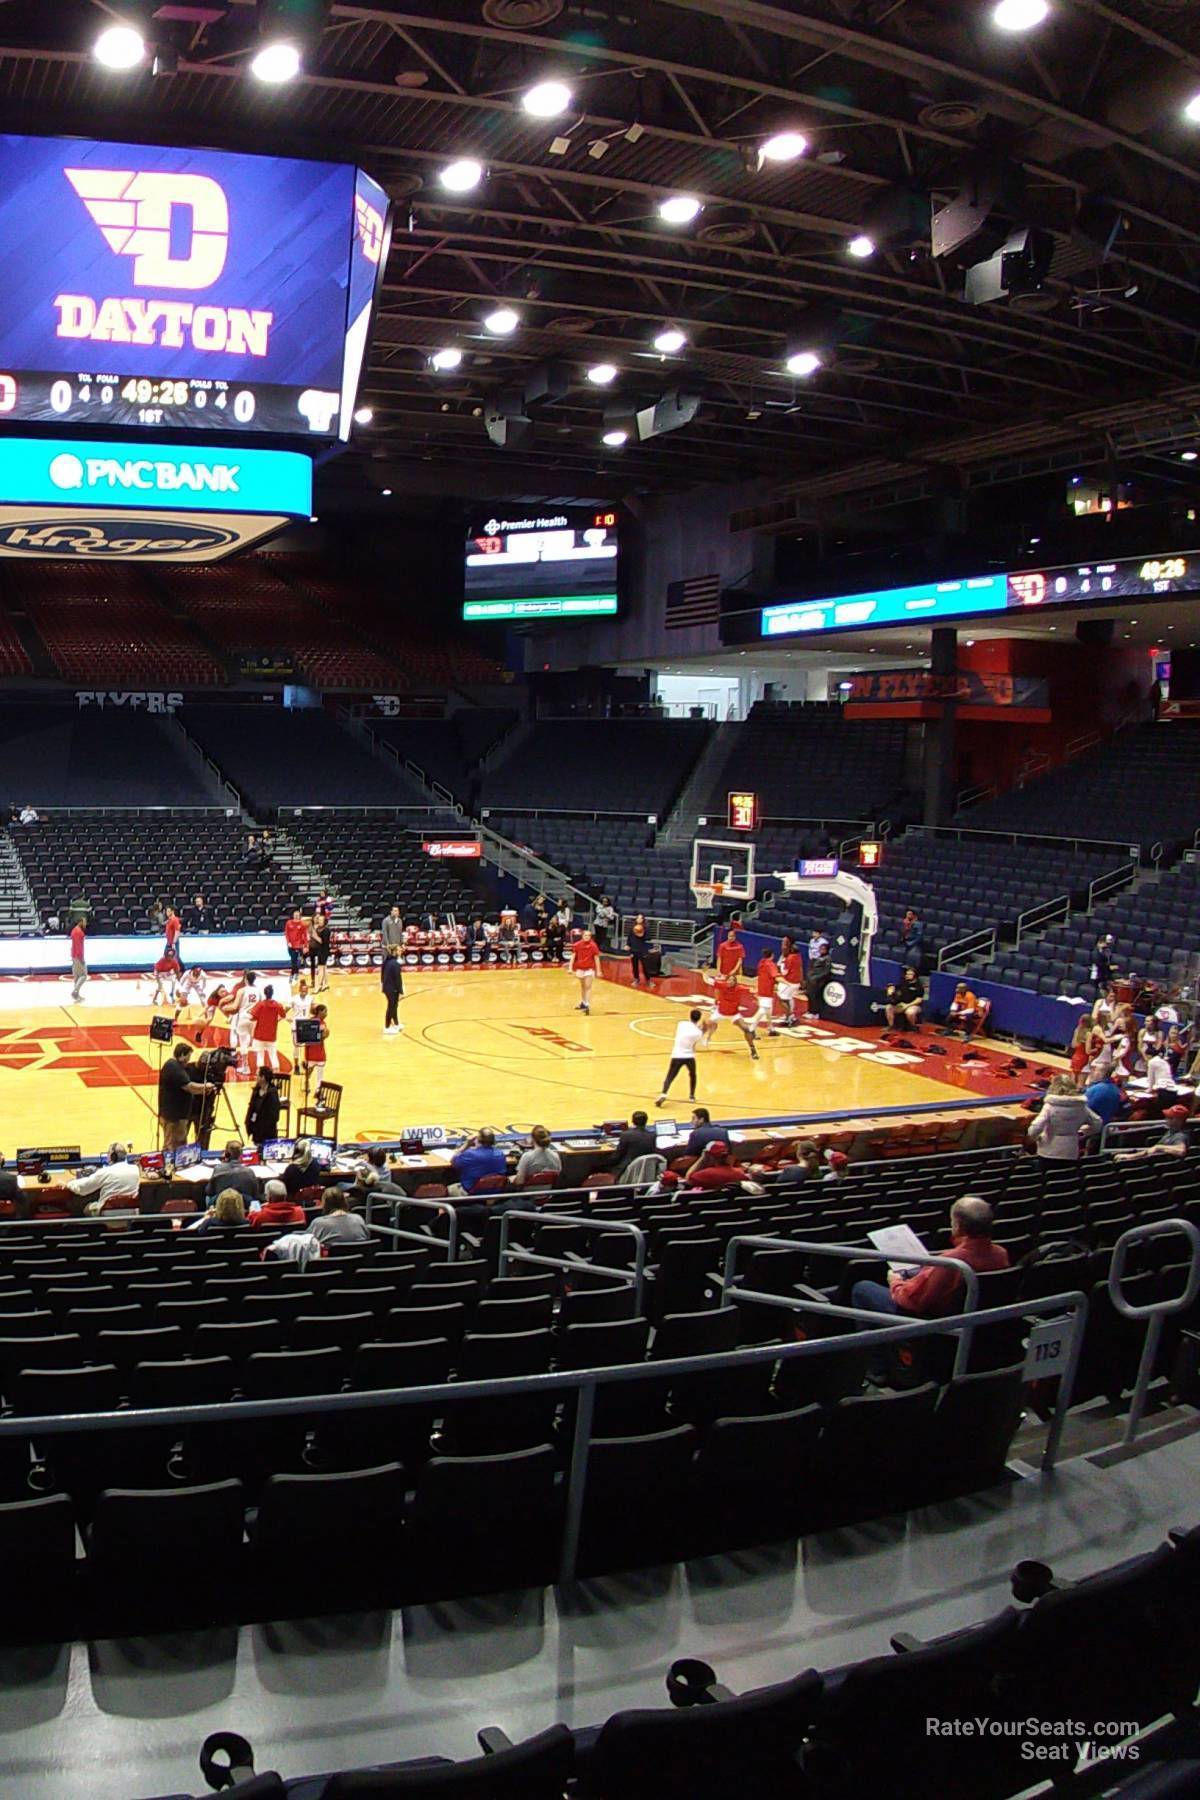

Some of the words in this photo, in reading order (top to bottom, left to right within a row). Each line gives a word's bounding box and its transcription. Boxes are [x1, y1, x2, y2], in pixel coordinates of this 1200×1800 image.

[53, 293, 273, 358] DAYTON
[51, 380, 72, 413] 0
[79, 385, 91, 402] 4
[102, 386, 114, 404] 0
[122, 379, 189, 405] 49:26
[194, 391, 207, 409] 0
[215, 392, 227, 409] 4
[138, 409, 163, 424] 1ST
[234, 390, 256, 423] 0
[501, 519, 535, 531] Premier
[536, 516, 567, 528] Health
[6, 525, 217, 555] Kroger
[1139, 559, 1187, 580] 49:26
[1153, 580, 1170, 592] 1ST
[734, 808, 751, 826] 30
[406, 1126, 443, 1139] WHIO
[1034, 1339, 1062, 1362] 113
